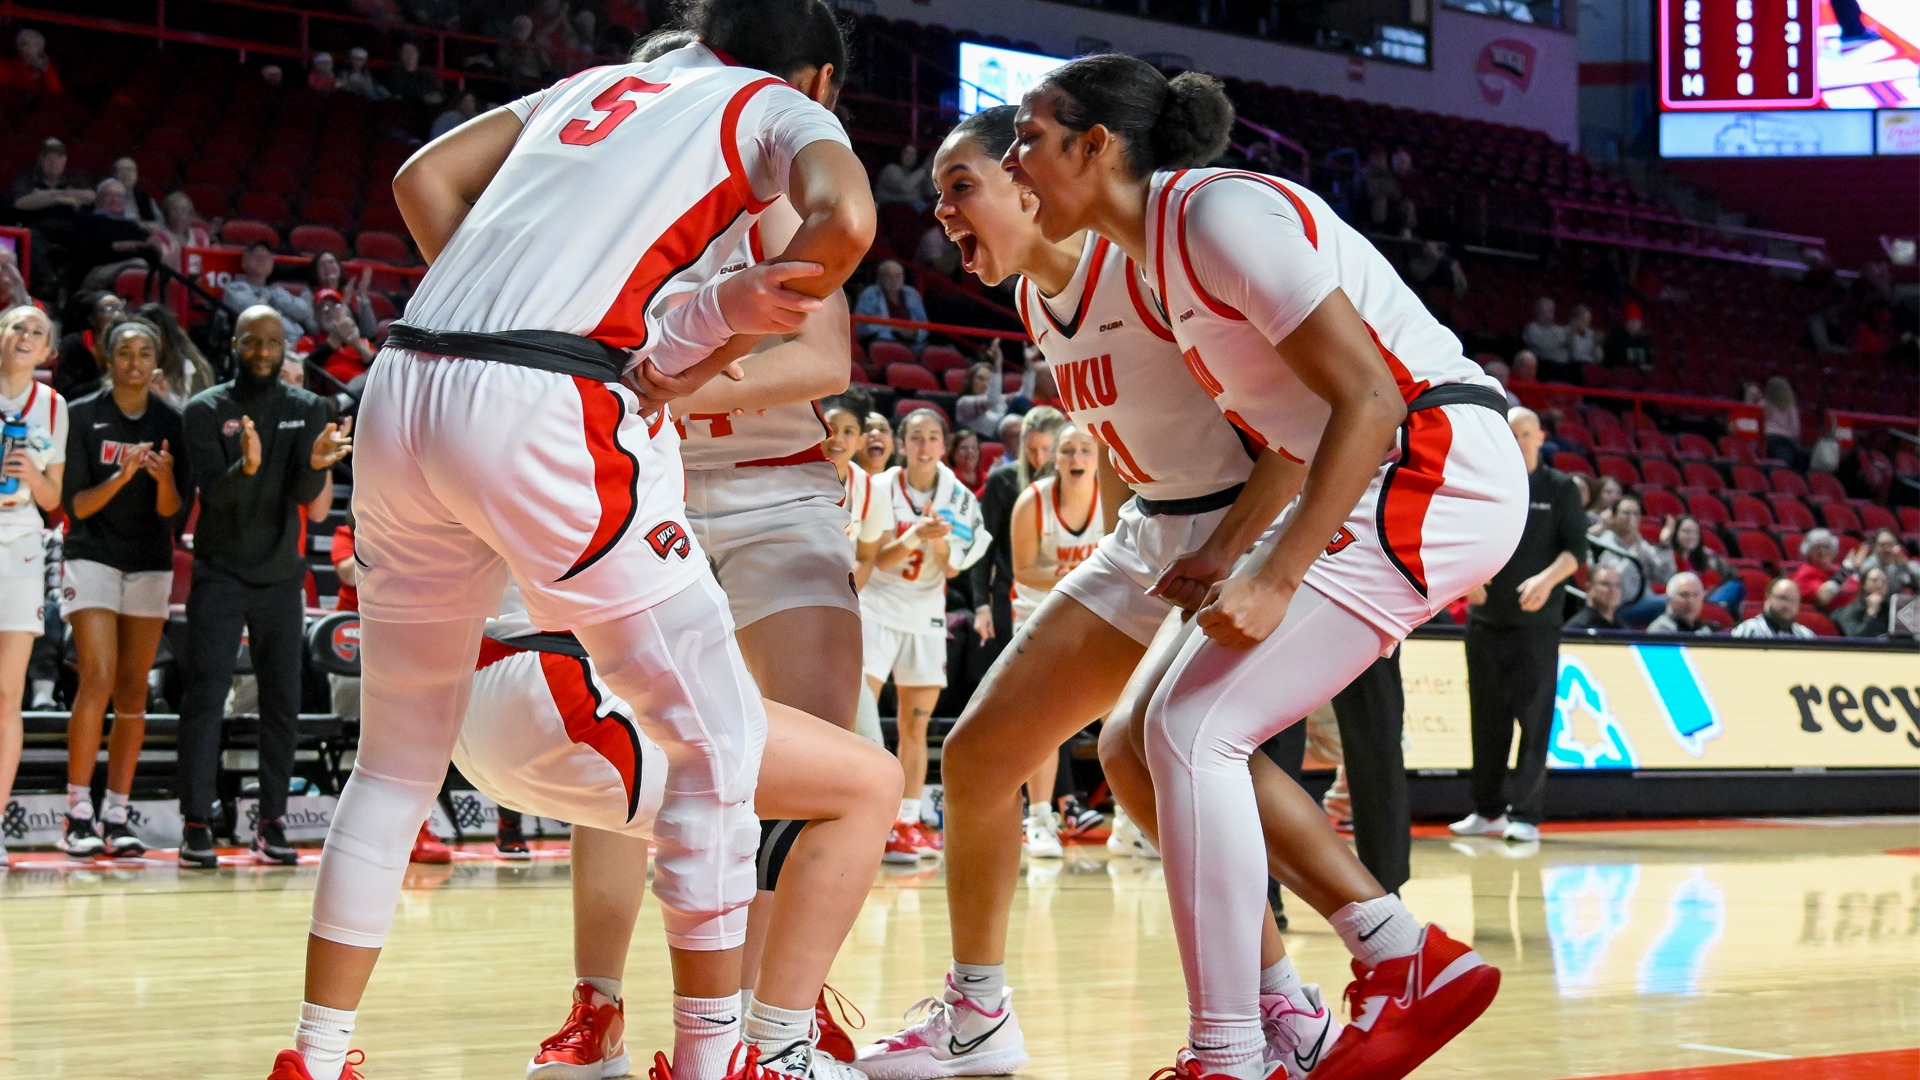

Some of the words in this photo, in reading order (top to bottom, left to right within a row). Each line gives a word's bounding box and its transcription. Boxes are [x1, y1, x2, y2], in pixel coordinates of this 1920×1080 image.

[1786, 0, 1798, 19] 1
[1684, 23, 1701, 46] 5
[1736, 22, 1753, 45] 9
[1784, 21, 1801, 44] 3
[1736, 46, 1753, 69] 7
[1787, 45, 1799, 68] 1
[1682, 74, 1704, 96] 14
[1787, 72, 1799, 95] 1
[558, 75, 672, 147] 5
[1055, 353, 1118, 412] WKU
[656, 525, 676, 546] WKU
[901, 548, 924, 581] 3
[1788, 684, 1920, 749] recy
